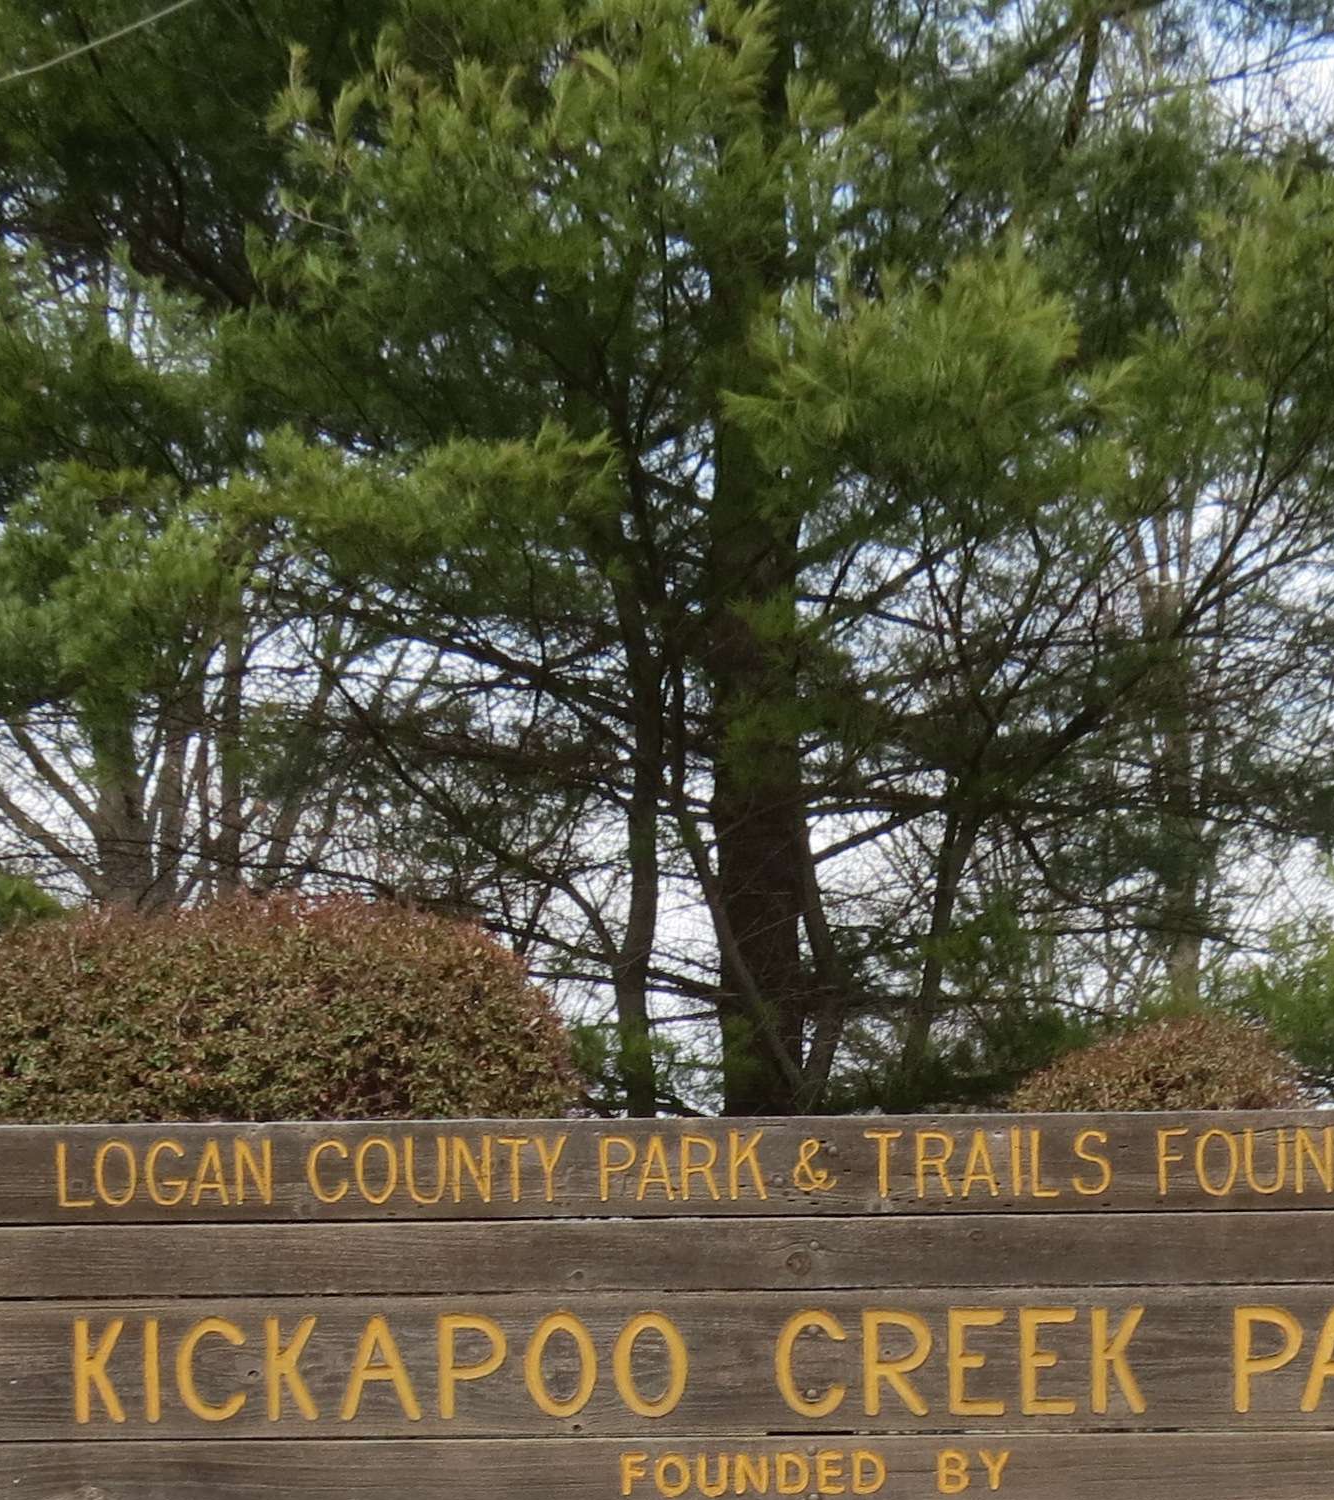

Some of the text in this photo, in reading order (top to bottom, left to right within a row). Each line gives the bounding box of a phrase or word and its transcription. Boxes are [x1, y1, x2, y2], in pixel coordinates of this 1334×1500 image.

[54, 1135, 274, 1208] LOGAN
[305, 1133, 568, 1206] COUNTY
[597, 1128, 769, 1202] PARK
[790, 1136, 838, 1193] &
[864, 1124, 1114, 1200] TRAILS
[70, 1308, 690, 1424] KICKAPOO
[773, 1303, 1147, 1418] CREEK
[618, 1445, 1013, 1499] FOUNDED BY
